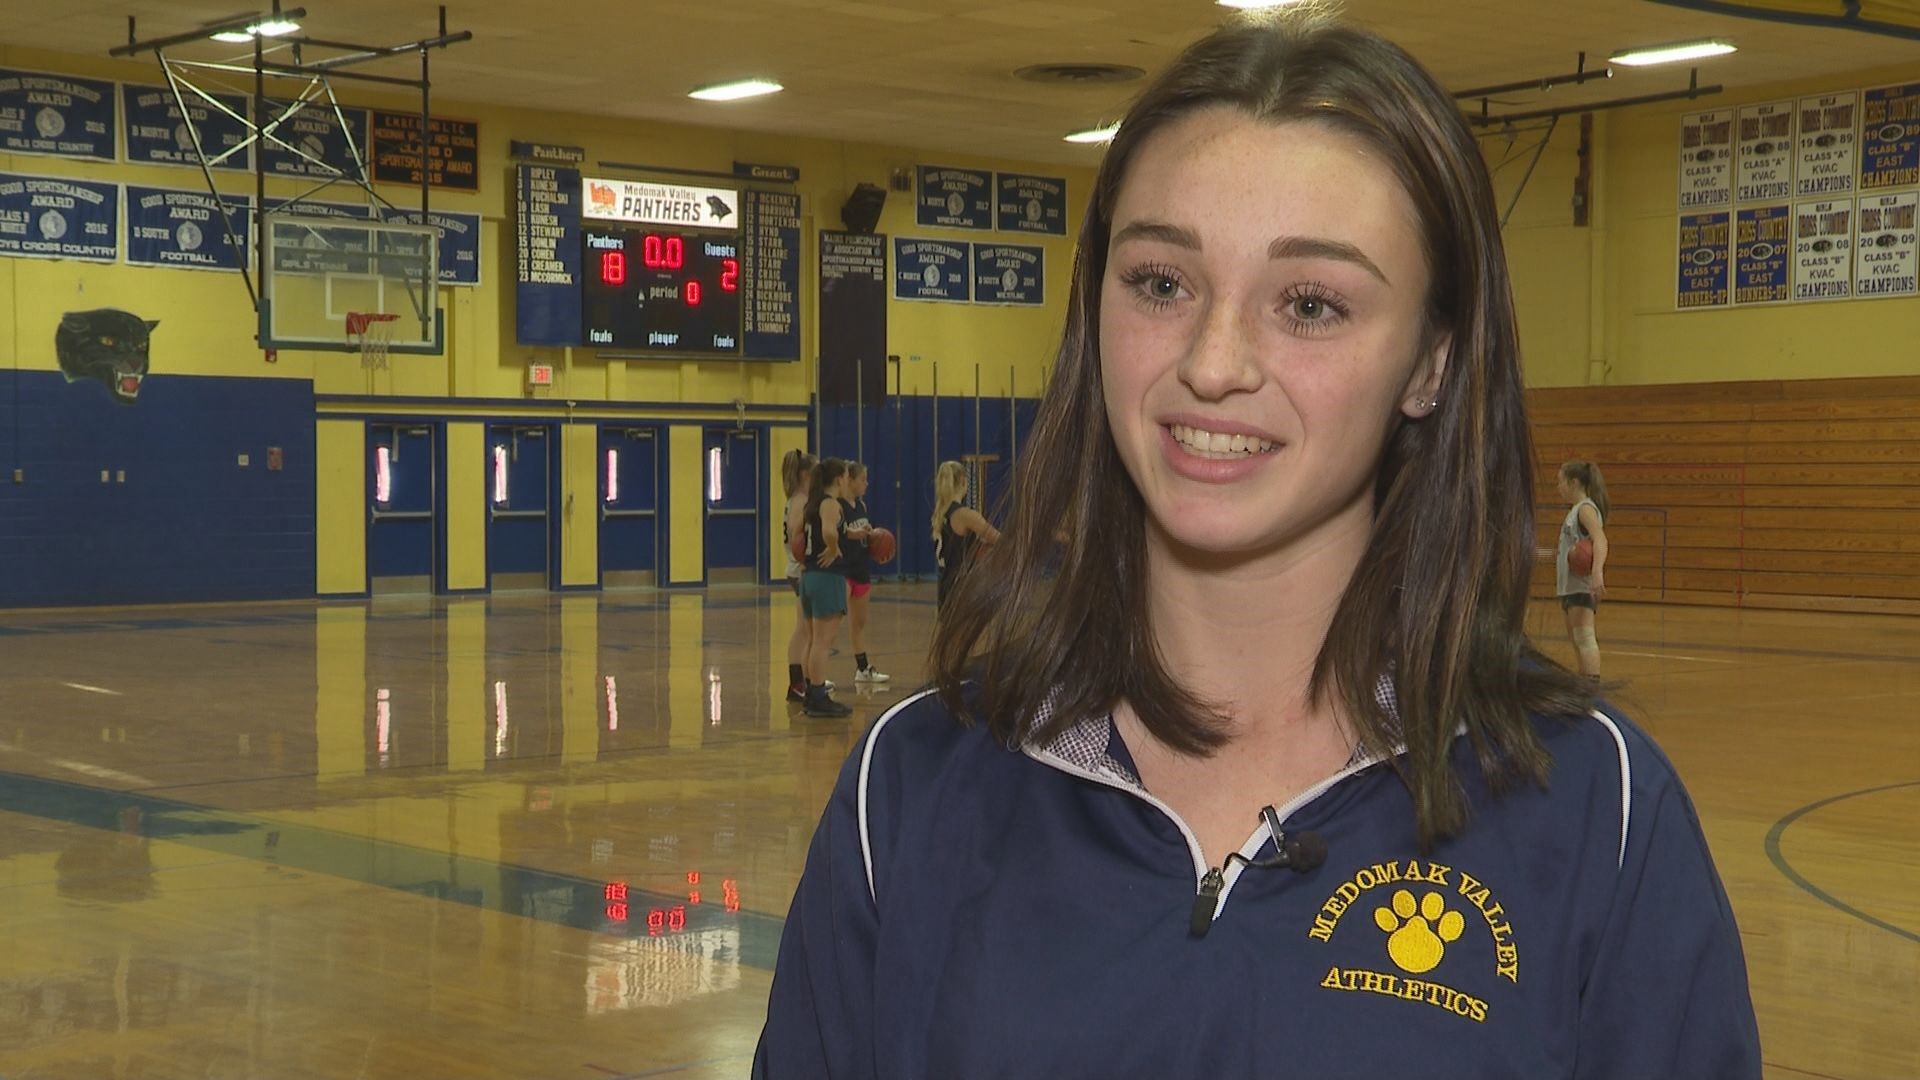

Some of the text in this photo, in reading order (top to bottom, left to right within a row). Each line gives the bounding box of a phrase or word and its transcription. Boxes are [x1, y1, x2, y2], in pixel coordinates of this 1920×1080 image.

[27, 91, 72, 107] AWARD
[1801, 133, 1853, 149] 19 89
[1864, 129, 1877, 141] 19
[533, 145, 583, 163] Panthers
[1741, 146, 1752, 156] 19
[1804, 152, 1831, 162] CLASS
[1868, 145, 1898, 156] CLASS
[1683, 153, 1694, 163] 19
[1744, 159, 1769, 169] CLASS
[1876, 156, 1904, 169] EAST
[1686, 166, 1711, 176] CLASS
[1812, 163, 1838, 174] KVAC
[1751, 170, 1776, 181] KVAC
[1861, 167, 1918, 189] CHAMPIONS
[942, 181, 968, 192] AWARD
[1693, 177, 1717, 188] KVAC
[1799, 175, 1851, 194] CHAMPIONS
[625, 184, 696, 203] Medomak Valley
[1681, 188, 1729, 206] CHAMPIONS
[1738, 182, 1788, 201] CHAMPIONS
[31, 195, 75, 209] AWARD
[517, 200, 550, 214] 10 LASH
[169, 207, 210, 221] AWARD
[622, 197, 702, 222] PANTHERS
[517, 212, 526, 224] 11
[759, 214, 800, 228] MORTENSEN
[518, 224, 565, 238] 12 STEWART
[518, 236, 528, 248] 15
[587, 233, 624, 250] Panthers
[759, 237, 783, 249] STARR
[1798, 240, 1849, 253] 20 08
[1861, 234, 1915, 248] 20 09
[22, 241, 116, 256] CROSS COUNTRY
[518, 248, 529, 259] 20
[644, 234, 685, 270] 0.0
[704, 241, 736, 259] Guests
[918, 242, 963, 260] SPORTSMANSHIP
[1738, 245, 1787, 259] 20 07
[160, 251, 217, 263] FOOTBALL
[918, 254, 946, 265] AWARD
[996, 258, 1021, 269] AWARD
[1680, 254, 1692, 264] 19
[1801, 257, 1828, 267] CLASS
[1864, 252, 1893, 263] CLASS
[518, 259, 564, 272] 21 CREAMER
[602, 251, 625, 285] 18
[758, 258, 782, 270] STARR
[1741, 262, 1767, 272] CLASS
[1872, 263, 1900, 275] KVAC
[518, 271, 529, 282] 23
[721, 258, 740, 291] 2
[758, 268, 781, 281] CRAIG
[1684, 267, 1709, 277] CLASS
[1810, 269, 1835, 280] KVAC
[1691, 278, 1714, 289] EAST
[1749, 273, 1774, 285] EAST
[1858, 276, 1913, 294] CHAMPIONS
[650, 285, 678, 300] period
[685, 280, 701, 306] 0
[918, 287, 948, 296] FOOTBALL
[1737, 284, 1788, 303] RUNNERS-UP
[1797, 280, 1848, 298] CHAMPIONS
[1679, 289, 1728, 306] RUNNERS-UP
[757, 300, 784, 312] BROWN
[590, 328, 613, 343] fouls
[649, 331, 679, 346] player
[713, 334, 735, 350] fouls
[1308, 859, 1519, 984] MEDOMAK VALLEY
[1320, 966, 1489, 1023] ATHLETICS
